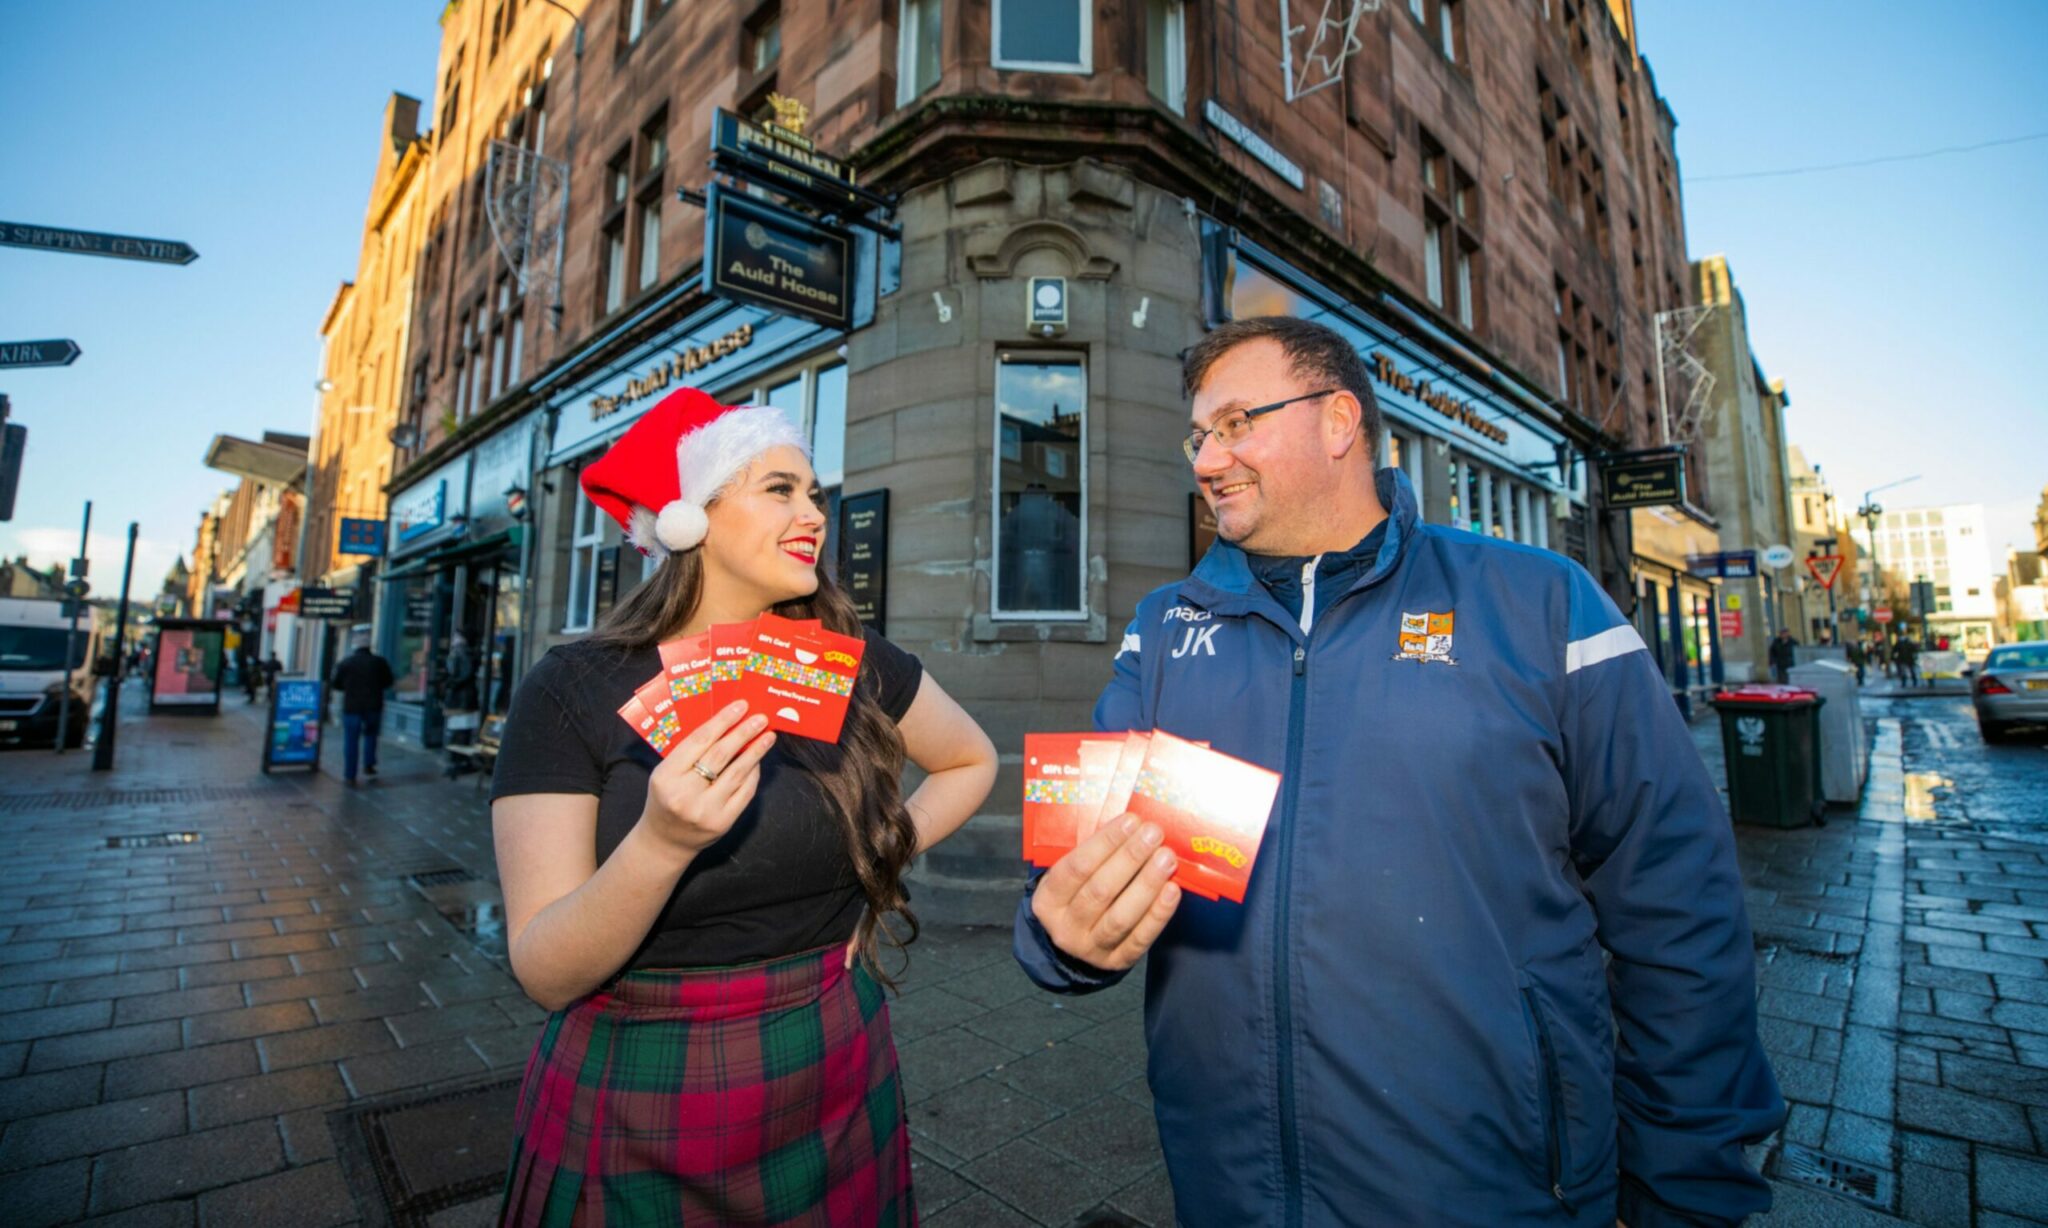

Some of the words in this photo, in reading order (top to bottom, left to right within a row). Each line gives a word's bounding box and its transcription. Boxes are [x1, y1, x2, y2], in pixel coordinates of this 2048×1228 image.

[112, 238, 182, 258] CENTRE
[769, 254, 804, 278] The
[729, 261, 775, 286] Auld
[781, 276, 838, 305] Hoose
[0, 344, 43, 362] KIRK
[1372, 352, 1415, 397] The
[716, 646, 734, 656] Gift
[1171, 623, 1223, 659] JK
[671, 663, 690, 675] Gift
[1042, 763, 1062, 775] Gift
[1190, 835, 1248, 869] SMYTHS
